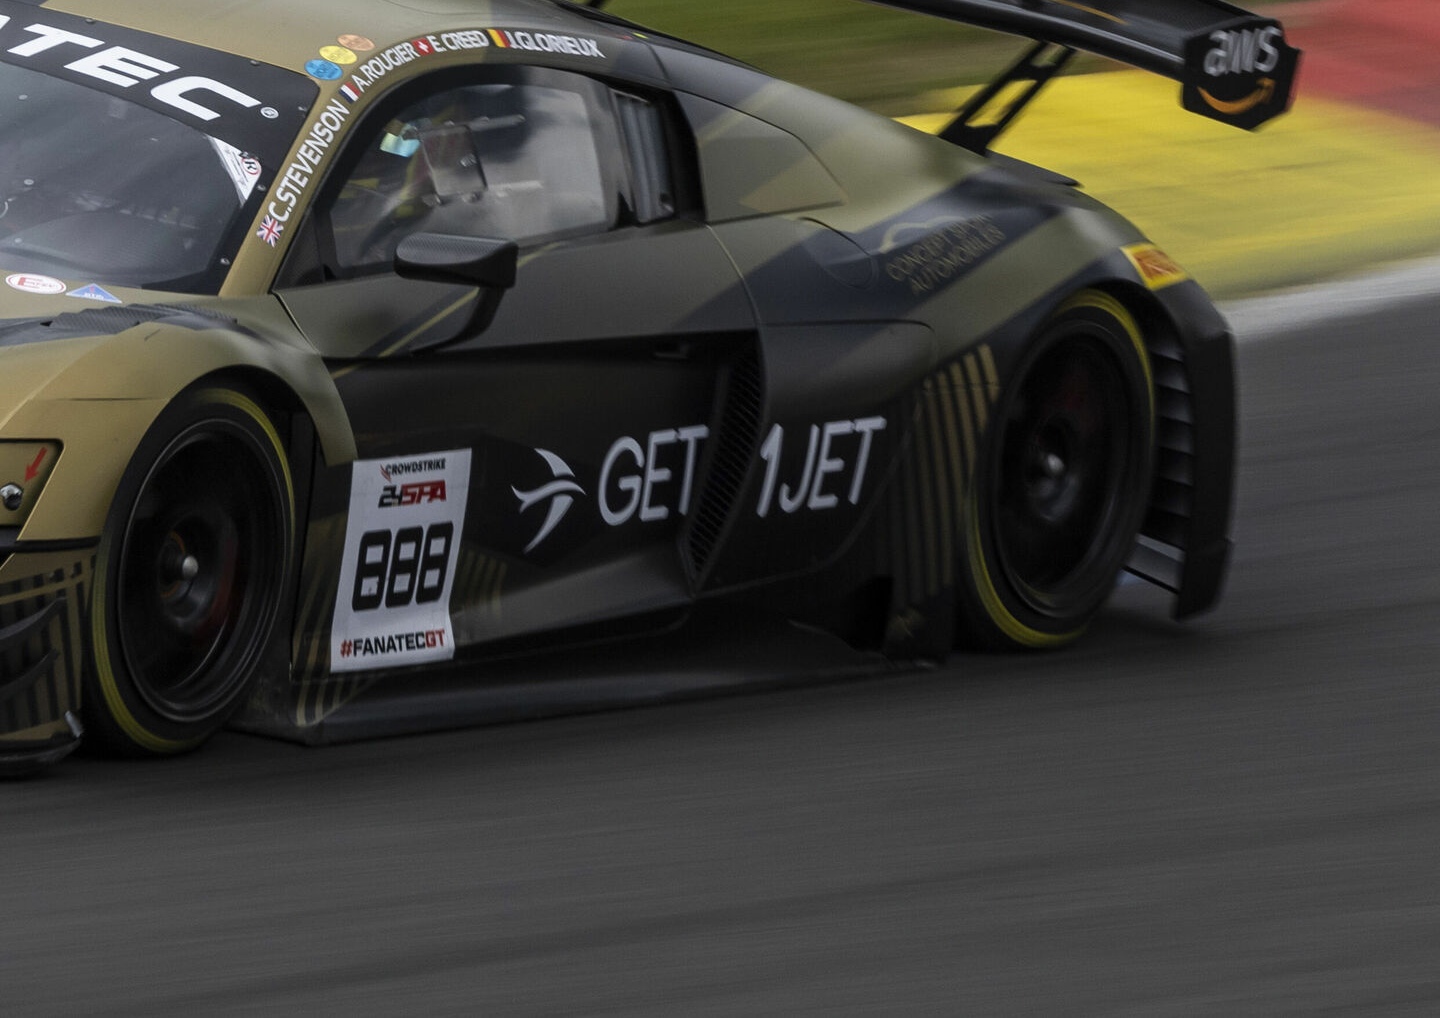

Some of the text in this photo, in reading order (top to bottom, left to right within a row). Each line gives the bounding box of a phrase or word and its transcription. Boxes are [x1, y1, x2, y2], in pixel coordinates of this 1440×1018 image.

[351, 40, 421, 93] A.ROUGIER
[1203, 25, 1281, 77] aws
[268, 98, 350, 222] C.STEVENSON
[386, 457, 446, 475] CROWDSTRIKE
[598, 424, 708, 526] GET
[351, 520, 454, 612] 888
[340, 629, 445, 657] #FANATECGT
